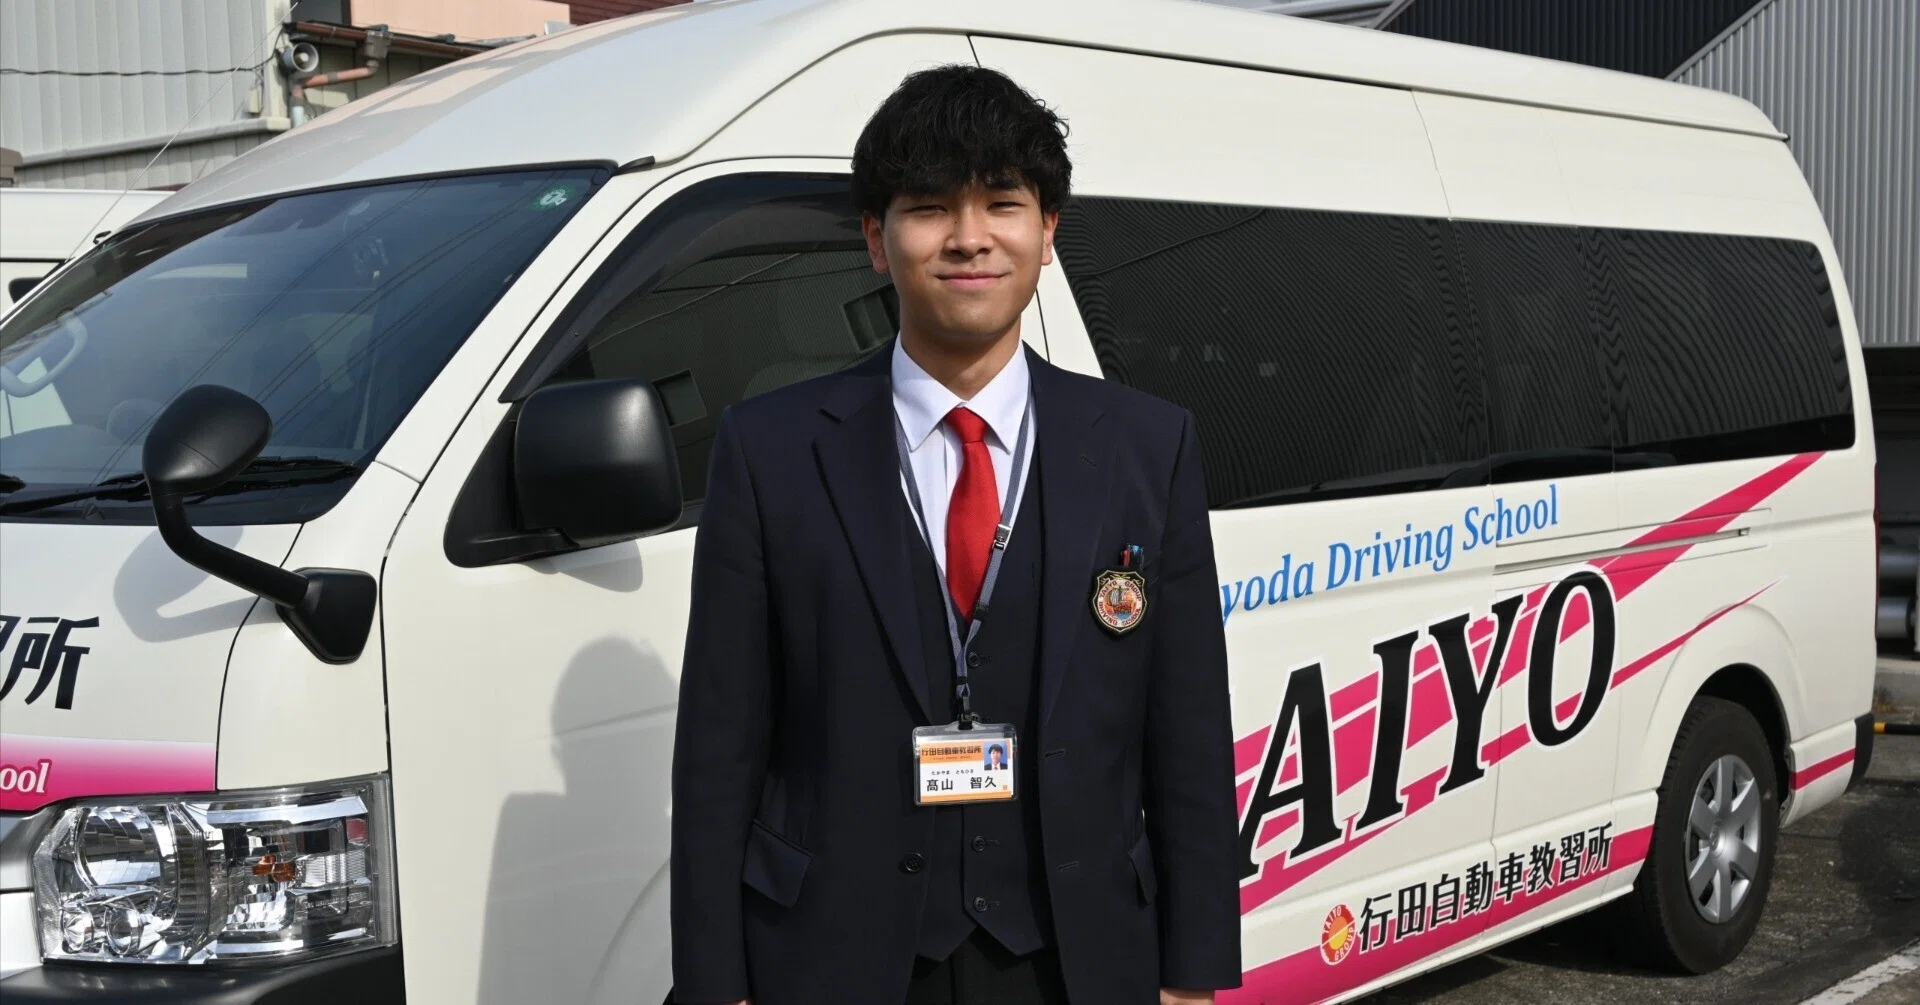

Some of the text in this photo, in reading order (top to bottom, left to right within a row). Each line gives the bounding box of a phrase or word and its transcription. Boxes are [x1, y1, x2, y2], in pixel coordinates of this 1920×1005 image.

[1326, 523, 1453, 591] Driving
[1463, 484, 1558, 551] School
[1124, 580, 1142, 602] GROUP
[970, 775, 997, 790] 智久
[1358, 821, 1613, 952] 行田自動車教習所
[1324, 905, 1342, 933] TAIYO
[1334, 926, 1354, 962] GROUP
